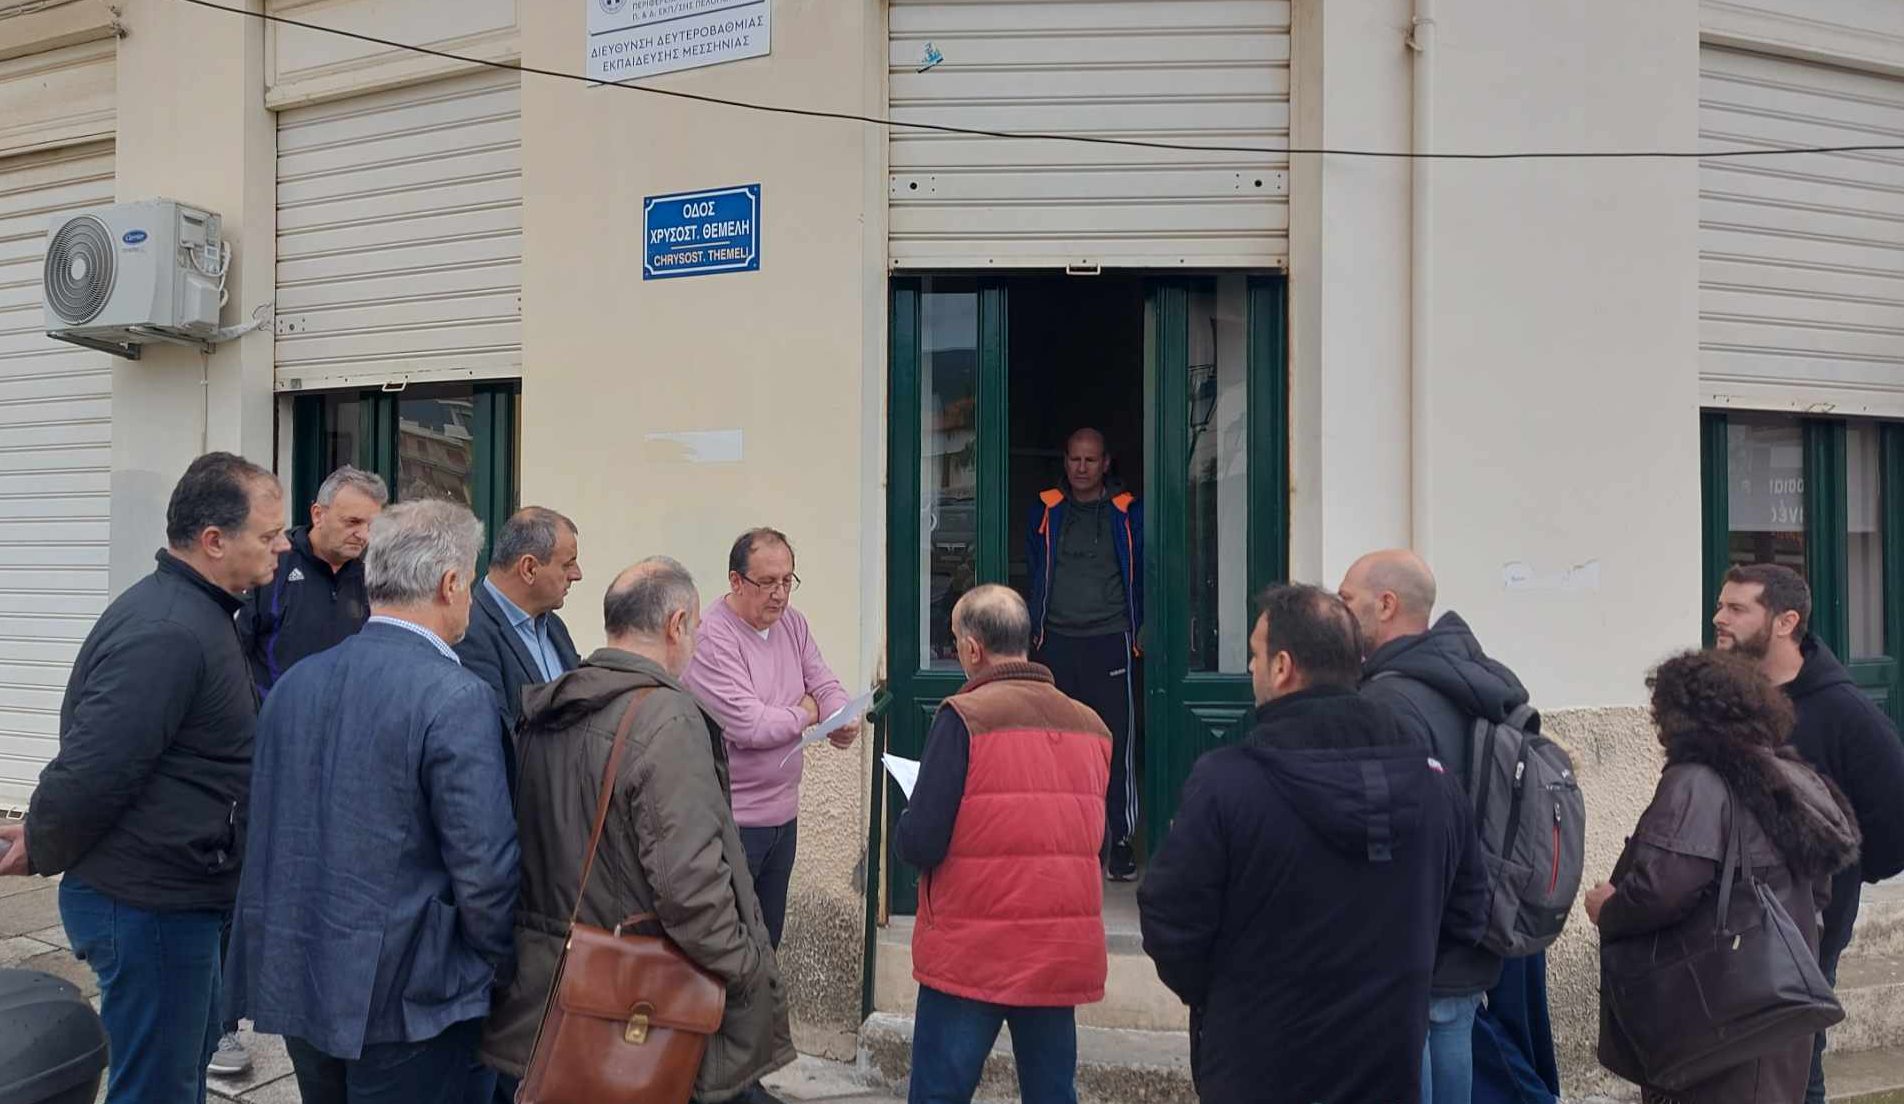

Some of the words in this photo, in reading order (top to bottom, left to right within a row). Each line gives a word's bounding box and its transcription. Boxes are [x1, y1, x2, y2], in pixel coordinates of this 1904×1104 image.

[592, 36, 654, 58] ΔΙΕΥΘΥΝΣΗ
[657, 15, 764, 46] ΔΕΥΤΕΡΟΒΑΘΜΙΑΣ
[603, 48, 679, 72] ΕΚΠΑΙΔΕΥΣΗΣ
[682, 35, 749, 58] ΜΕΣΣΗΝΙΑΣ
[683, 201, 715, 218] ΟΔΟΣ
[650, 225, 700, 244] ΧΡΥΣΟΣΤ.
[702, 219, 750, 239] ΘΕΜΕΛΗ
[653, 251, 706, 266] CHRYSOST.
[708, 246, 749, 261] THEMELI
